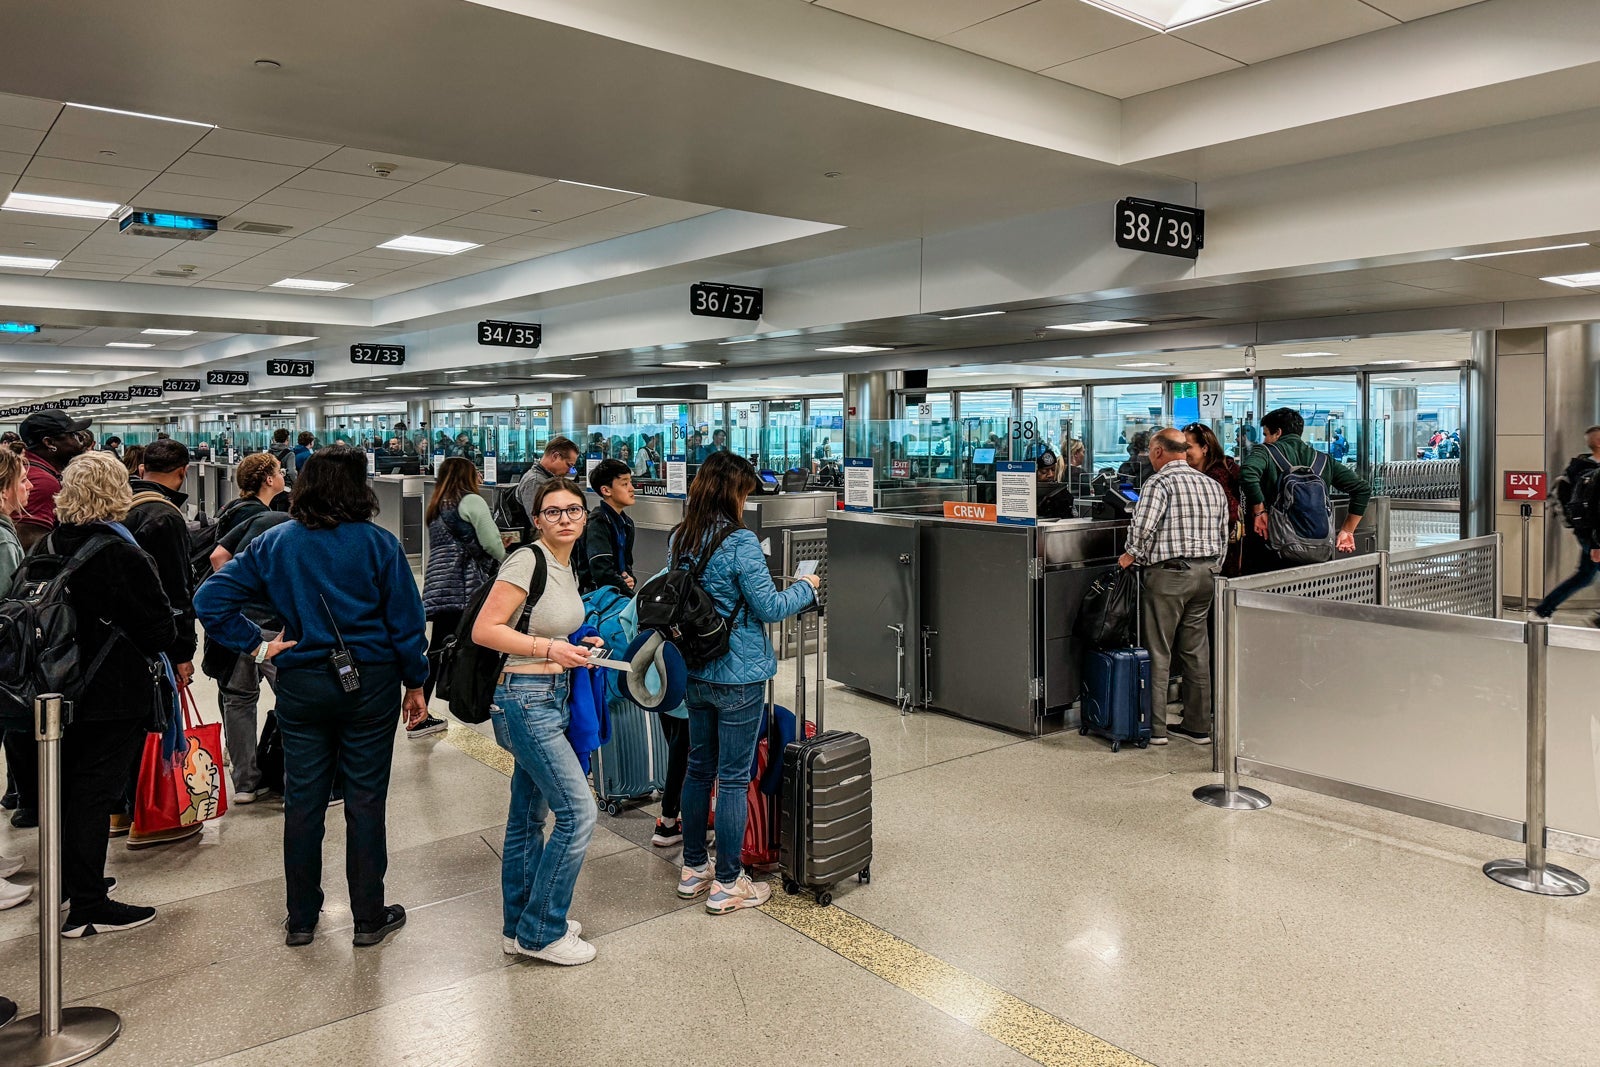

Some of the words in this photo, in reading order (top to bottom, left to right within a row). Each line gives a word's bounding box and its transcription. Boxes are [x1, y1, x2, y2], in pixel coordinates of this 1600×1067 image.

[1202, 394, 1218, 406] 37
[739, 410, 747, 419] 33
[919, 404, 930, 415] 35
[674, 426, 686, 440] 36
[1012, 420, 1034, 440] 38
[893, 460, 909, 468] EXIT
[1510, 474, 1542, 485] EXIT
[644, 485, 667, 495] LIAISON
[953, 504, 986, 519] CREW
